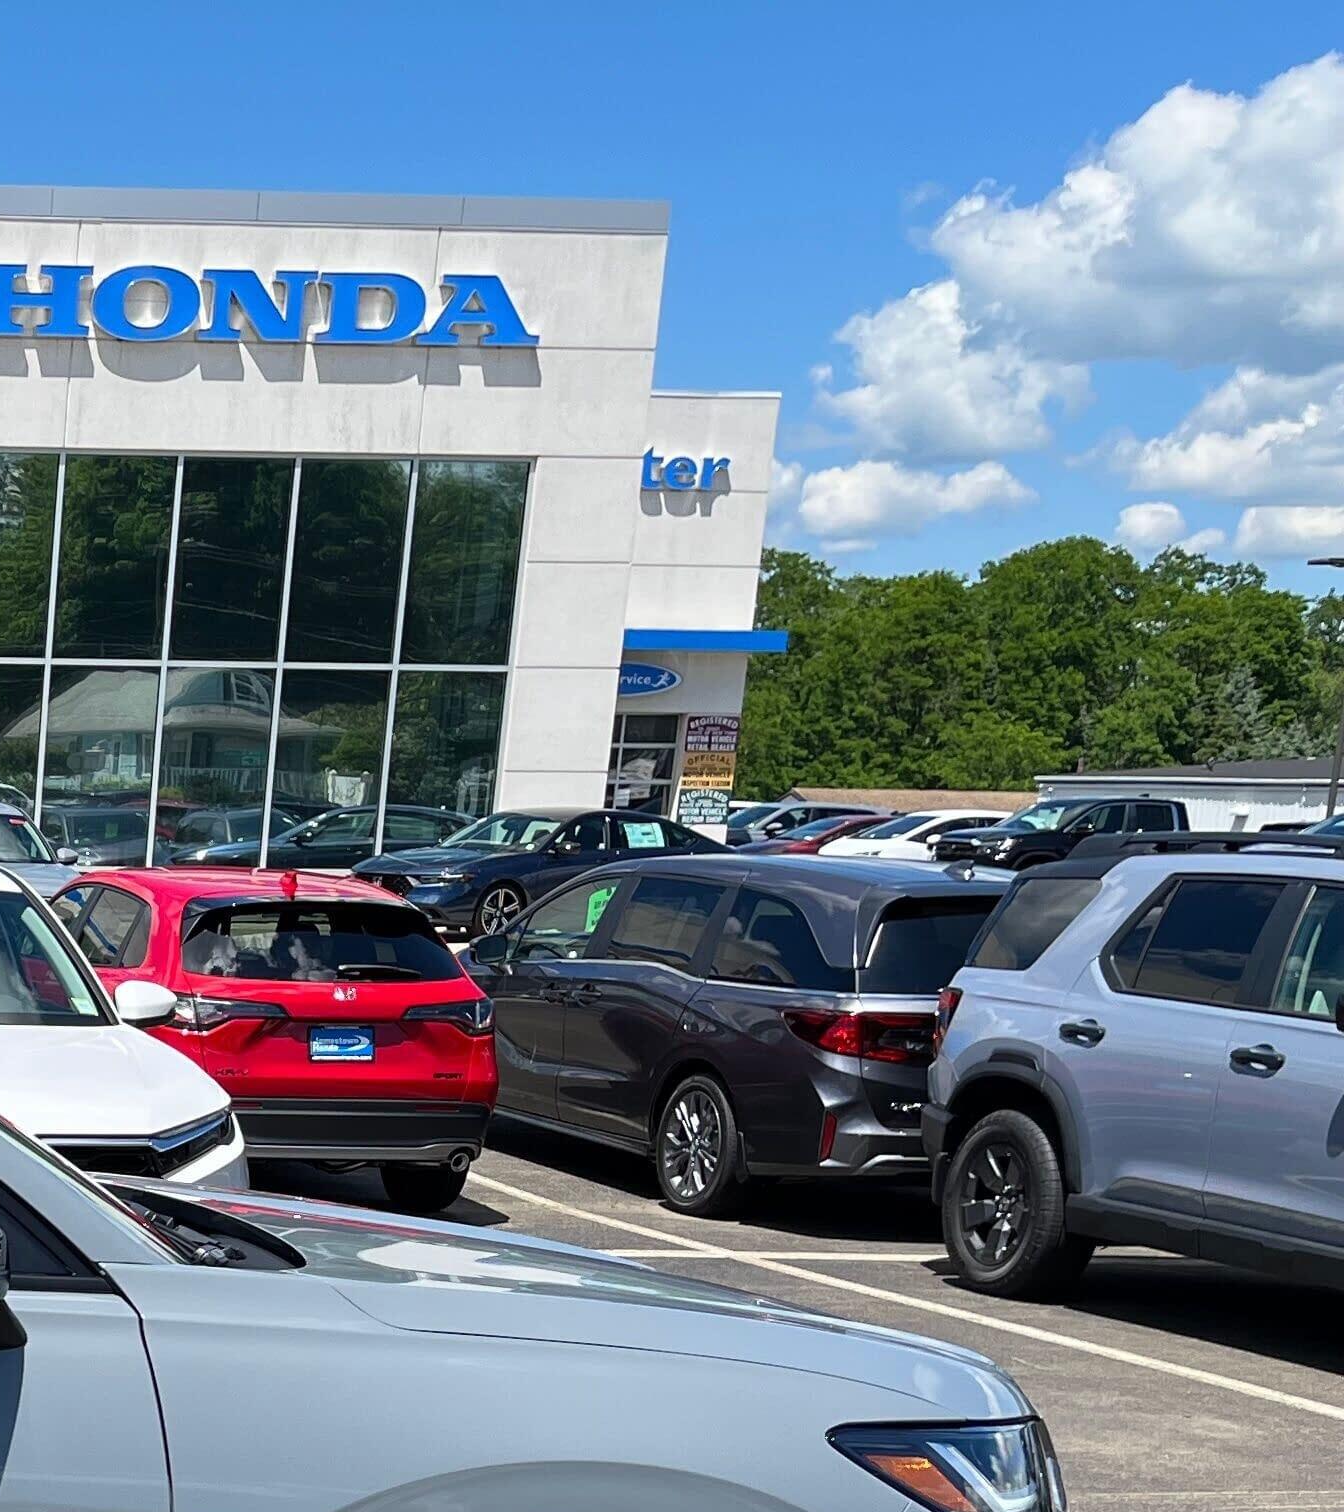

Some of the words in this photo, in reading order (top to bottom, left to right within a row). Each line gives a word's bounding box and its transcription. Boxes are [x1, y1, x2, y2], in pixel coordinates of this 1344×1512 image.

[641, 446, 731, 490] ter
[690, 716, 739, 730] REGISTERED
[687, 754, 731, 766] OFFICIAL
